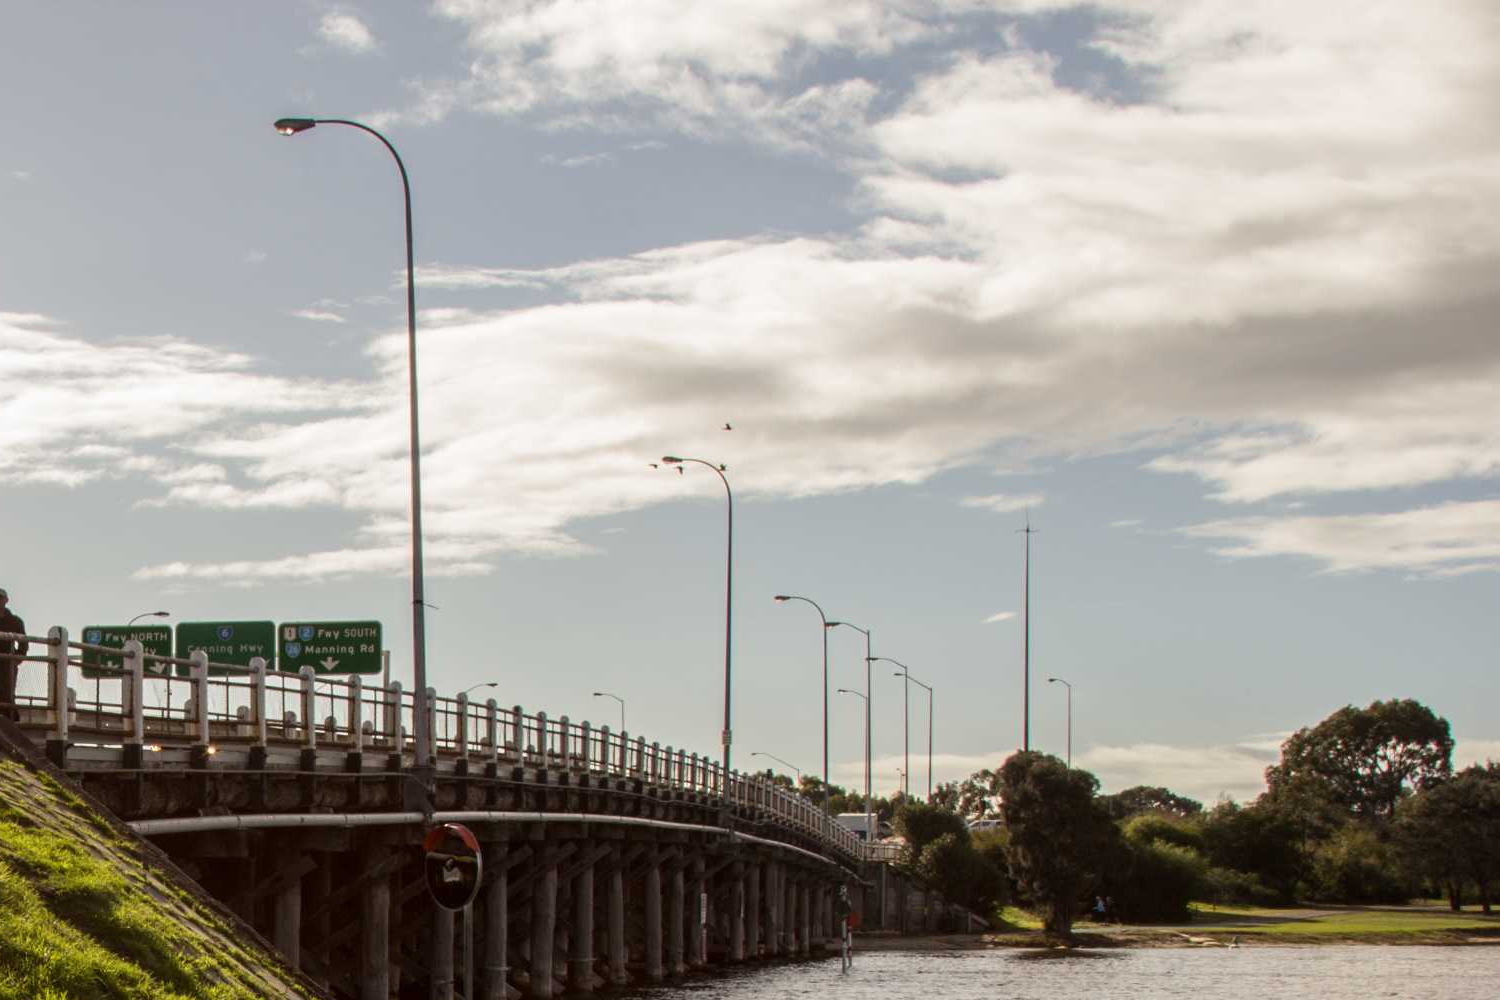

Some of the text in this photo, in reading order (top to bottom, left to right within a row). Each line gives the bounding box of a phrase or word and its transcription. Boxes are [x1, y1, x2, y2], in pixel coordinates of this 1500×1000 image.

[105, 633, 127, 643] Fwy
[131, 632, 168, 641] NORTH
[317, 629, 340, 640] Fwy
[344, 628, 376, 638] SOUTH
[240, 643, 264, 653] Hwy
[304, 645, 354, 655] Manning
[360, 644, 375, 653] Rd
